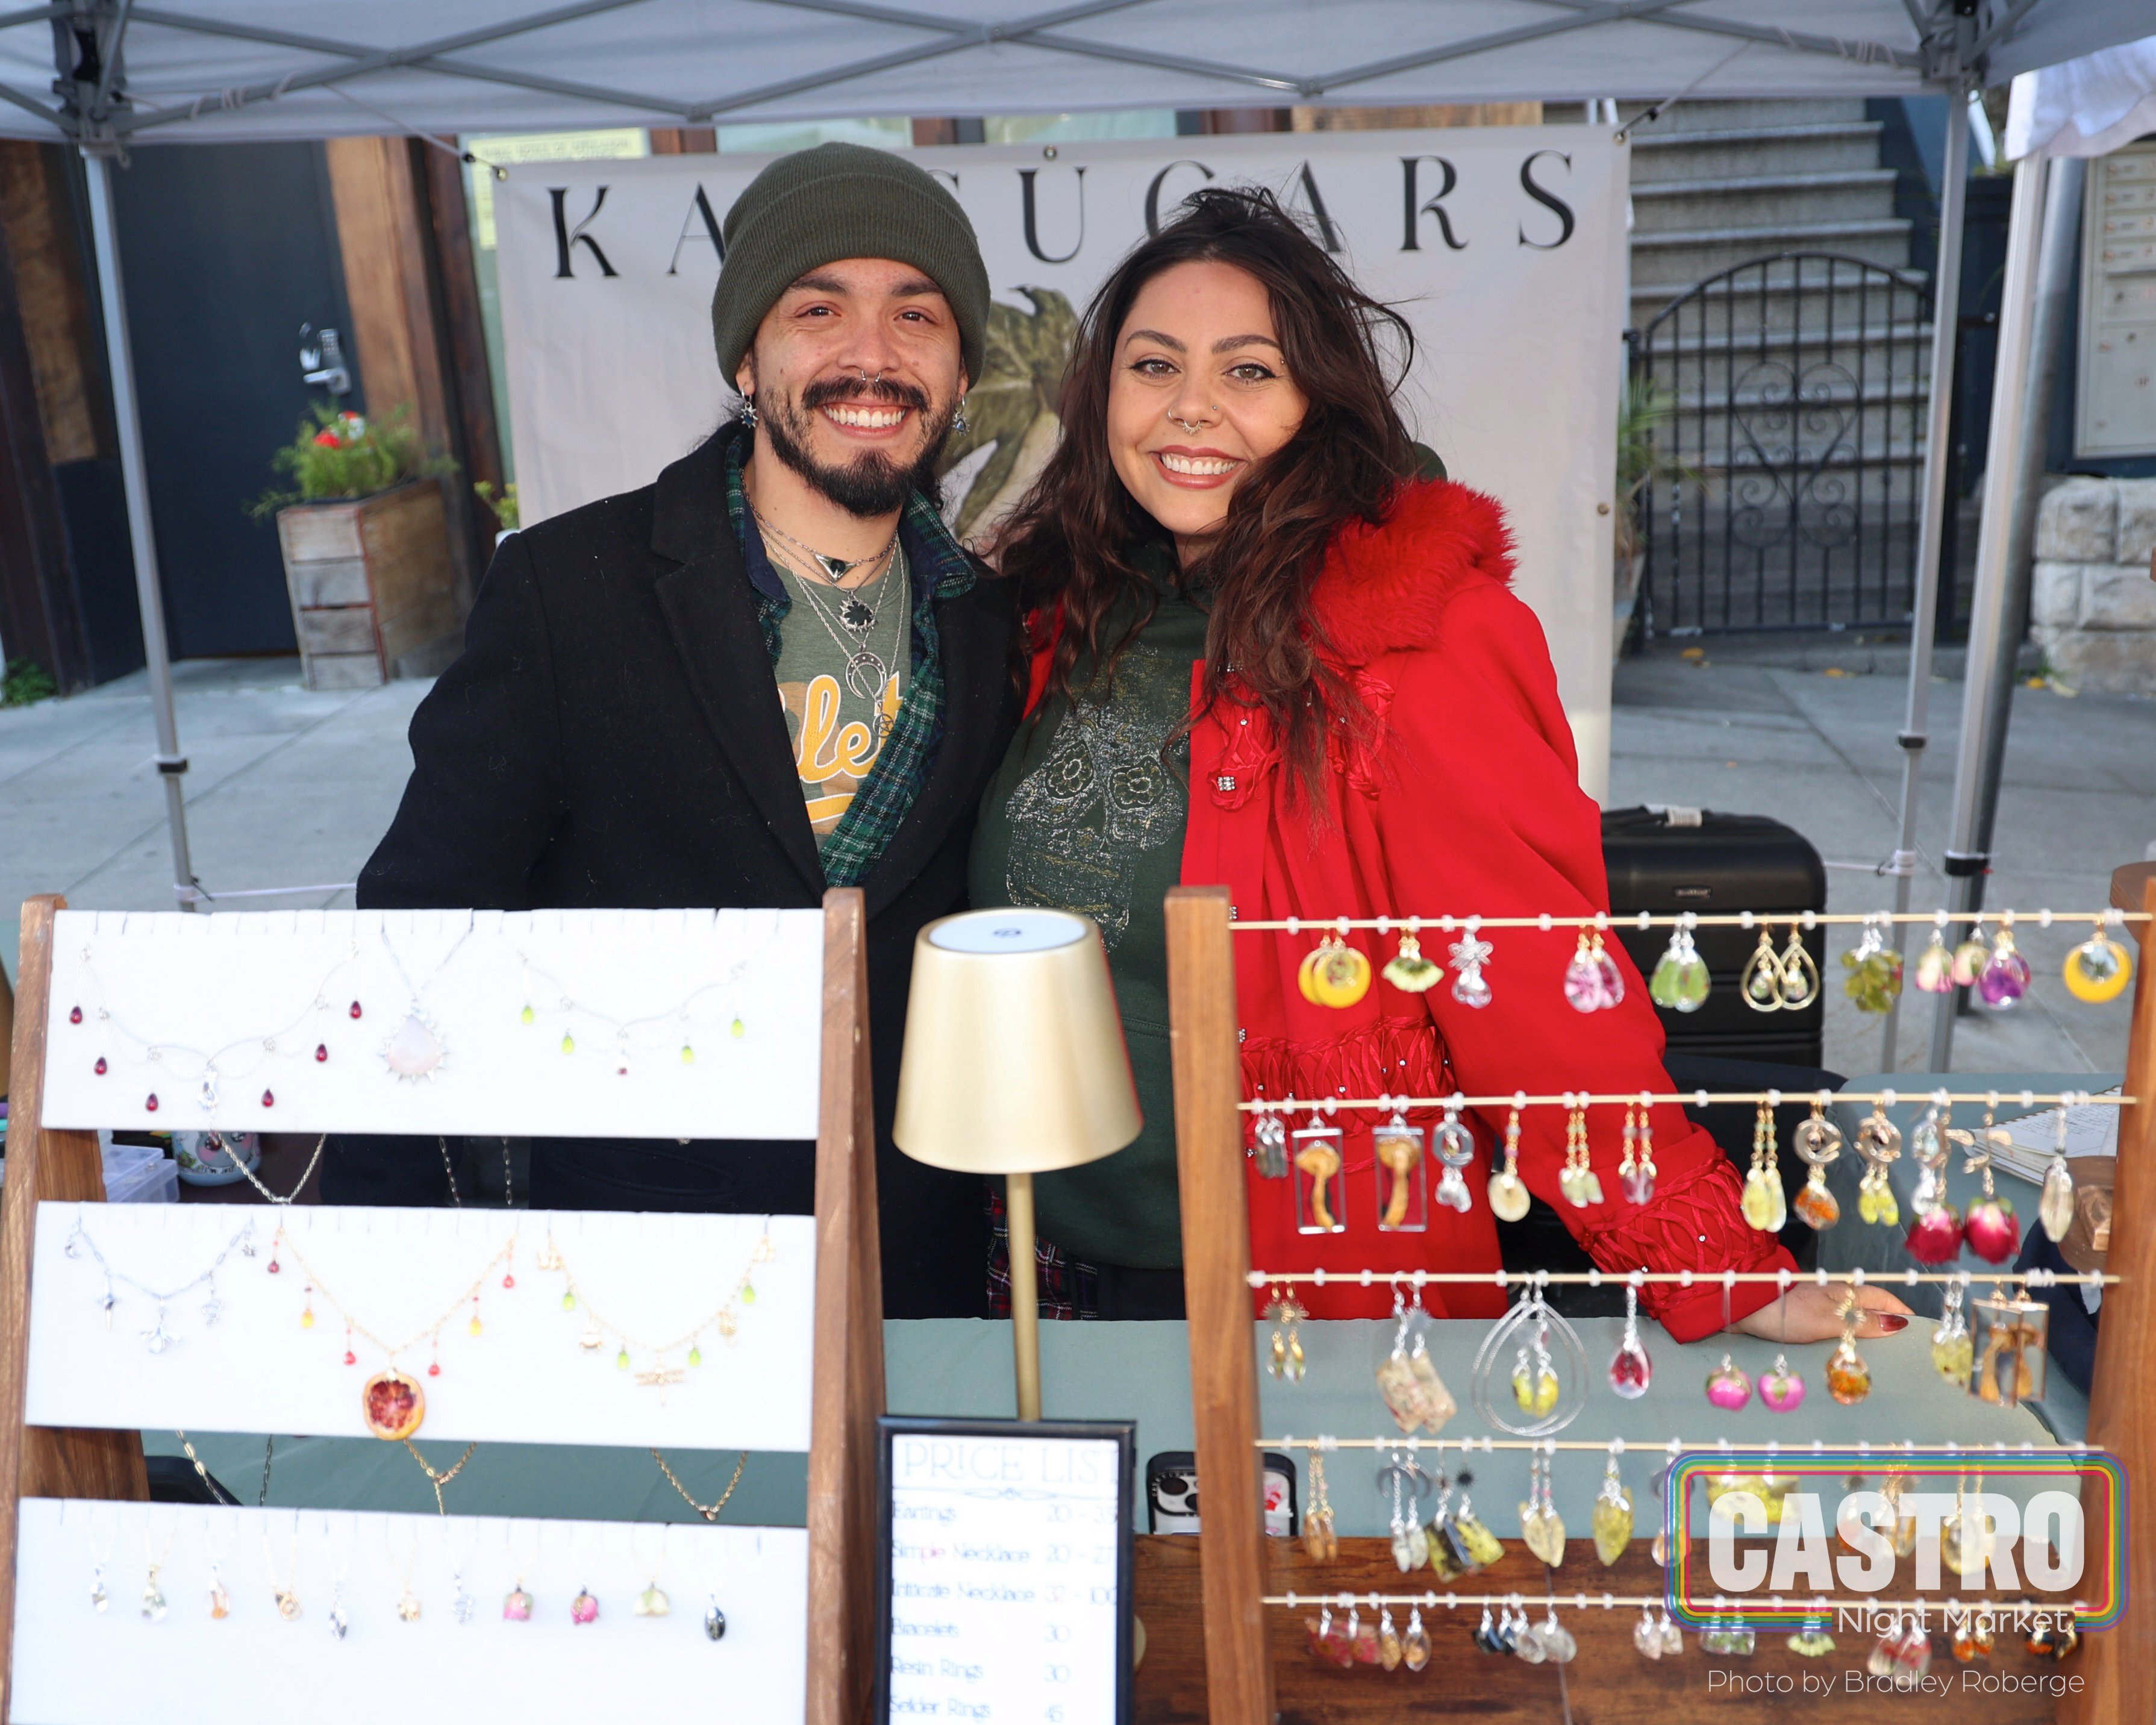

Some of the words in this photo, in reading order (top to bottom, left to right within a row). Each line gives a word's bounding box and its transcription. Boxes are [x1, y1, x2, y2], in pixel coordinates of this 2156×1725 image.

[904, 1442, 1023, 1480] PRICE
[1046, 1504, 1072, 1524] 20
[1046, 1544, 1072, 1564] 20
[1045, 1624, 1072, 1644] 30
[940, 1658, 984, 1684] Rings
[1045, 1664, 1072, 1683] 30
[947, 1697, 992, 1723] Rings
